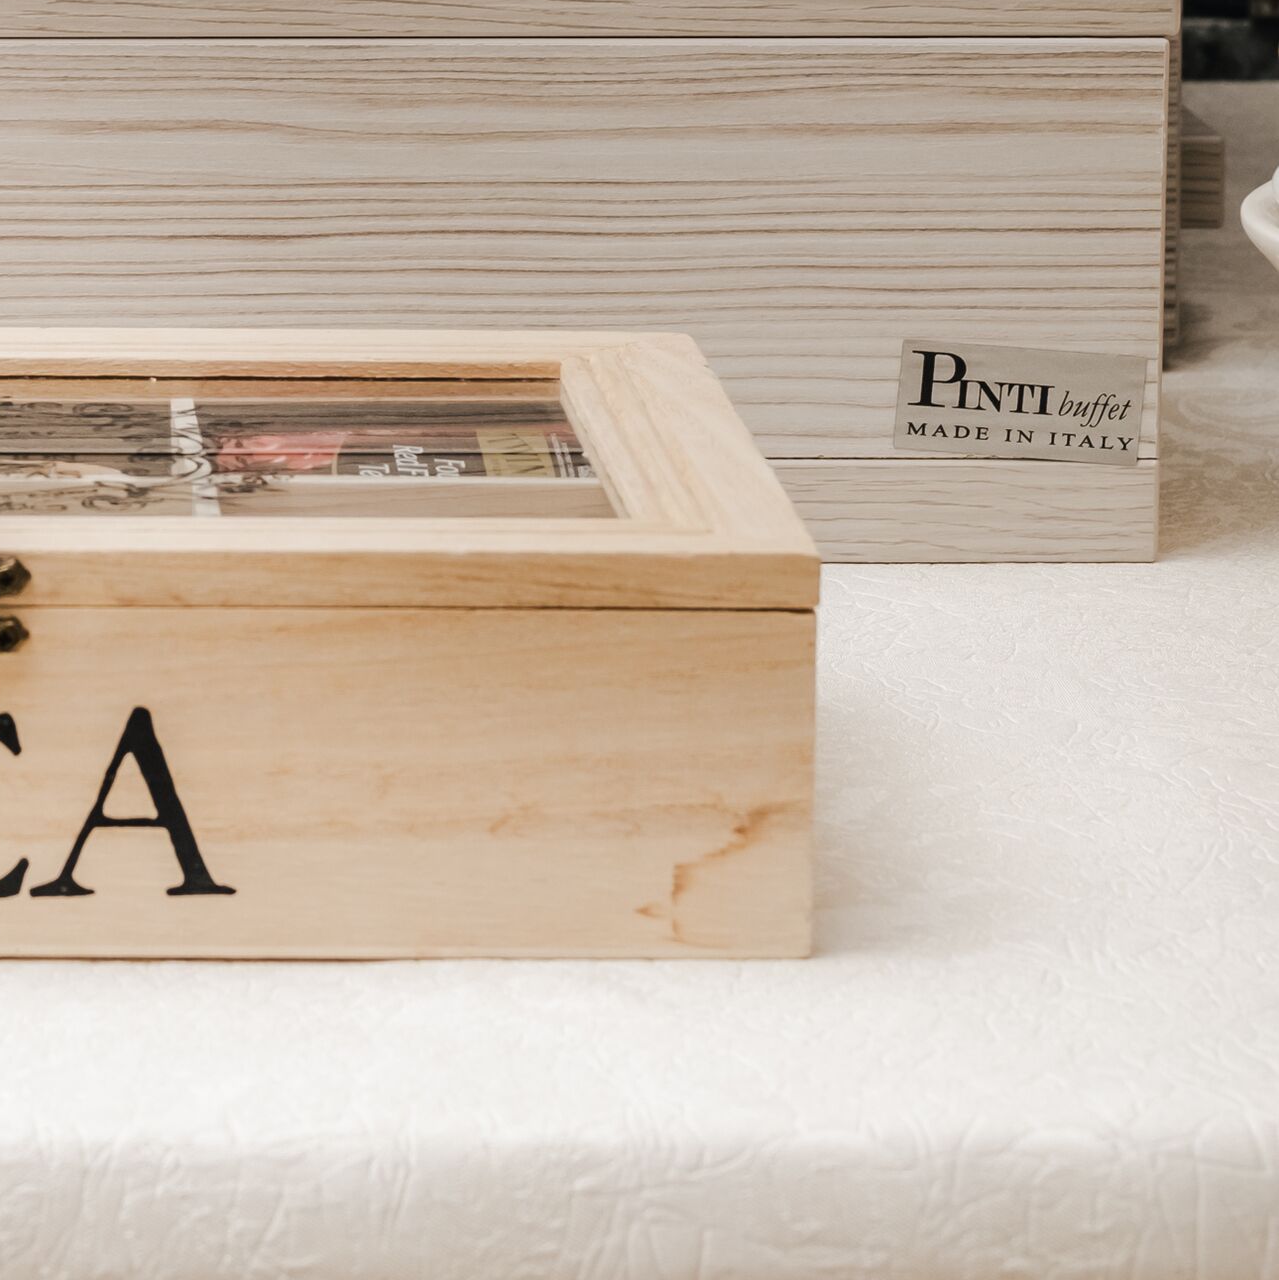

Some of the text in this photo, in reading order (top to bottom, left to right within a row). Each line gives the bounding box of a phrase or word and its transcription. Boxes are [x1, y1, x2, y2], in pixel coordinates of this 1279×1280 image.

[907, 350, 1132, 428] PINTI buffet
[906, 421, 1134, 451] MADE IN ITALY
